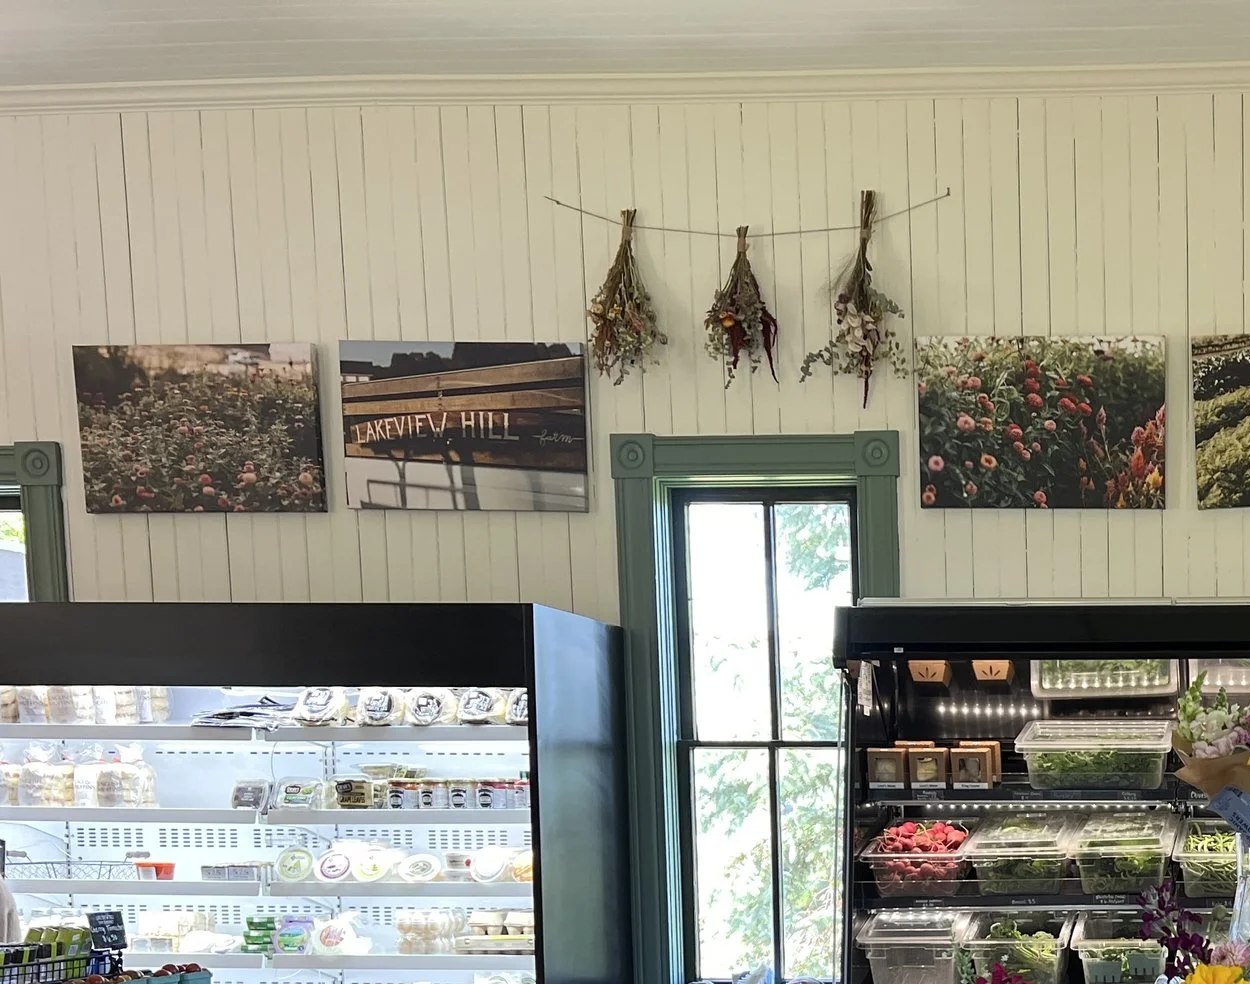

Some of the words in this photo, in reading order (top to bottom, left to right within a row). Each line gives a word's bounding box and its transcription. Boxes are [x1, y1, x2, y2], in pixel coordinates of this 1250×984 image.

[354, 411, 448, 444] LAKEVIEW
[460, 411, 520, 441] HILL
[533, 429, 584, 446] farm
